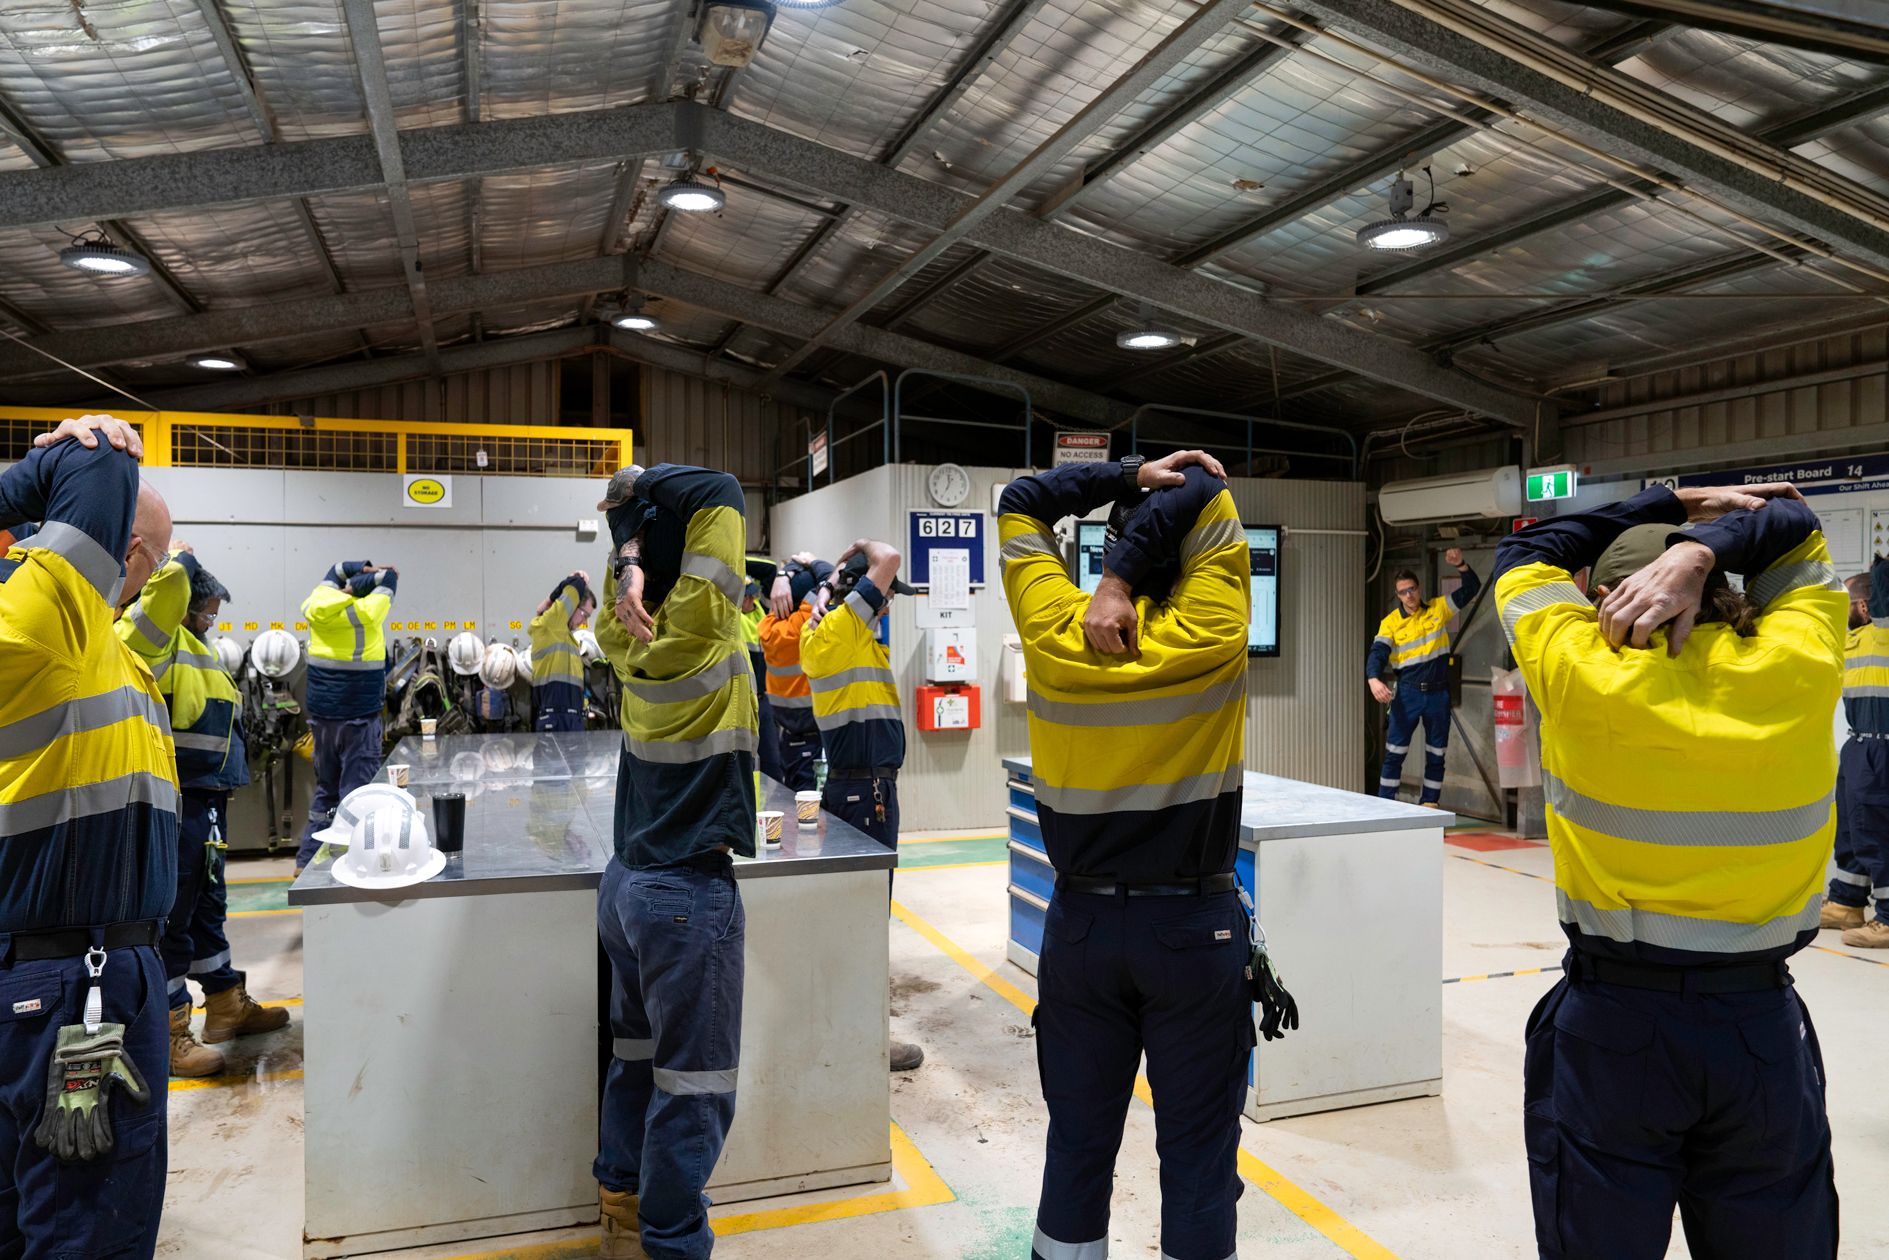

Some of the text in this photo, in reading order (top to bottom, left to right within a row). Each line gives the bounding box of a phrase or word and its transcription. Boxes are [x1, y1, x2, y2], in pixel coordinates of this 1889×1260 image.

[1073, 451, 1104, 459] ACCESS
[1744, 464, 1863, 485] Pre-start Board 14
[1839, 484, 1852, 492] Our
[1853, 483, 1870, 491] Shift
[940, 611, 952, 619] KIT
